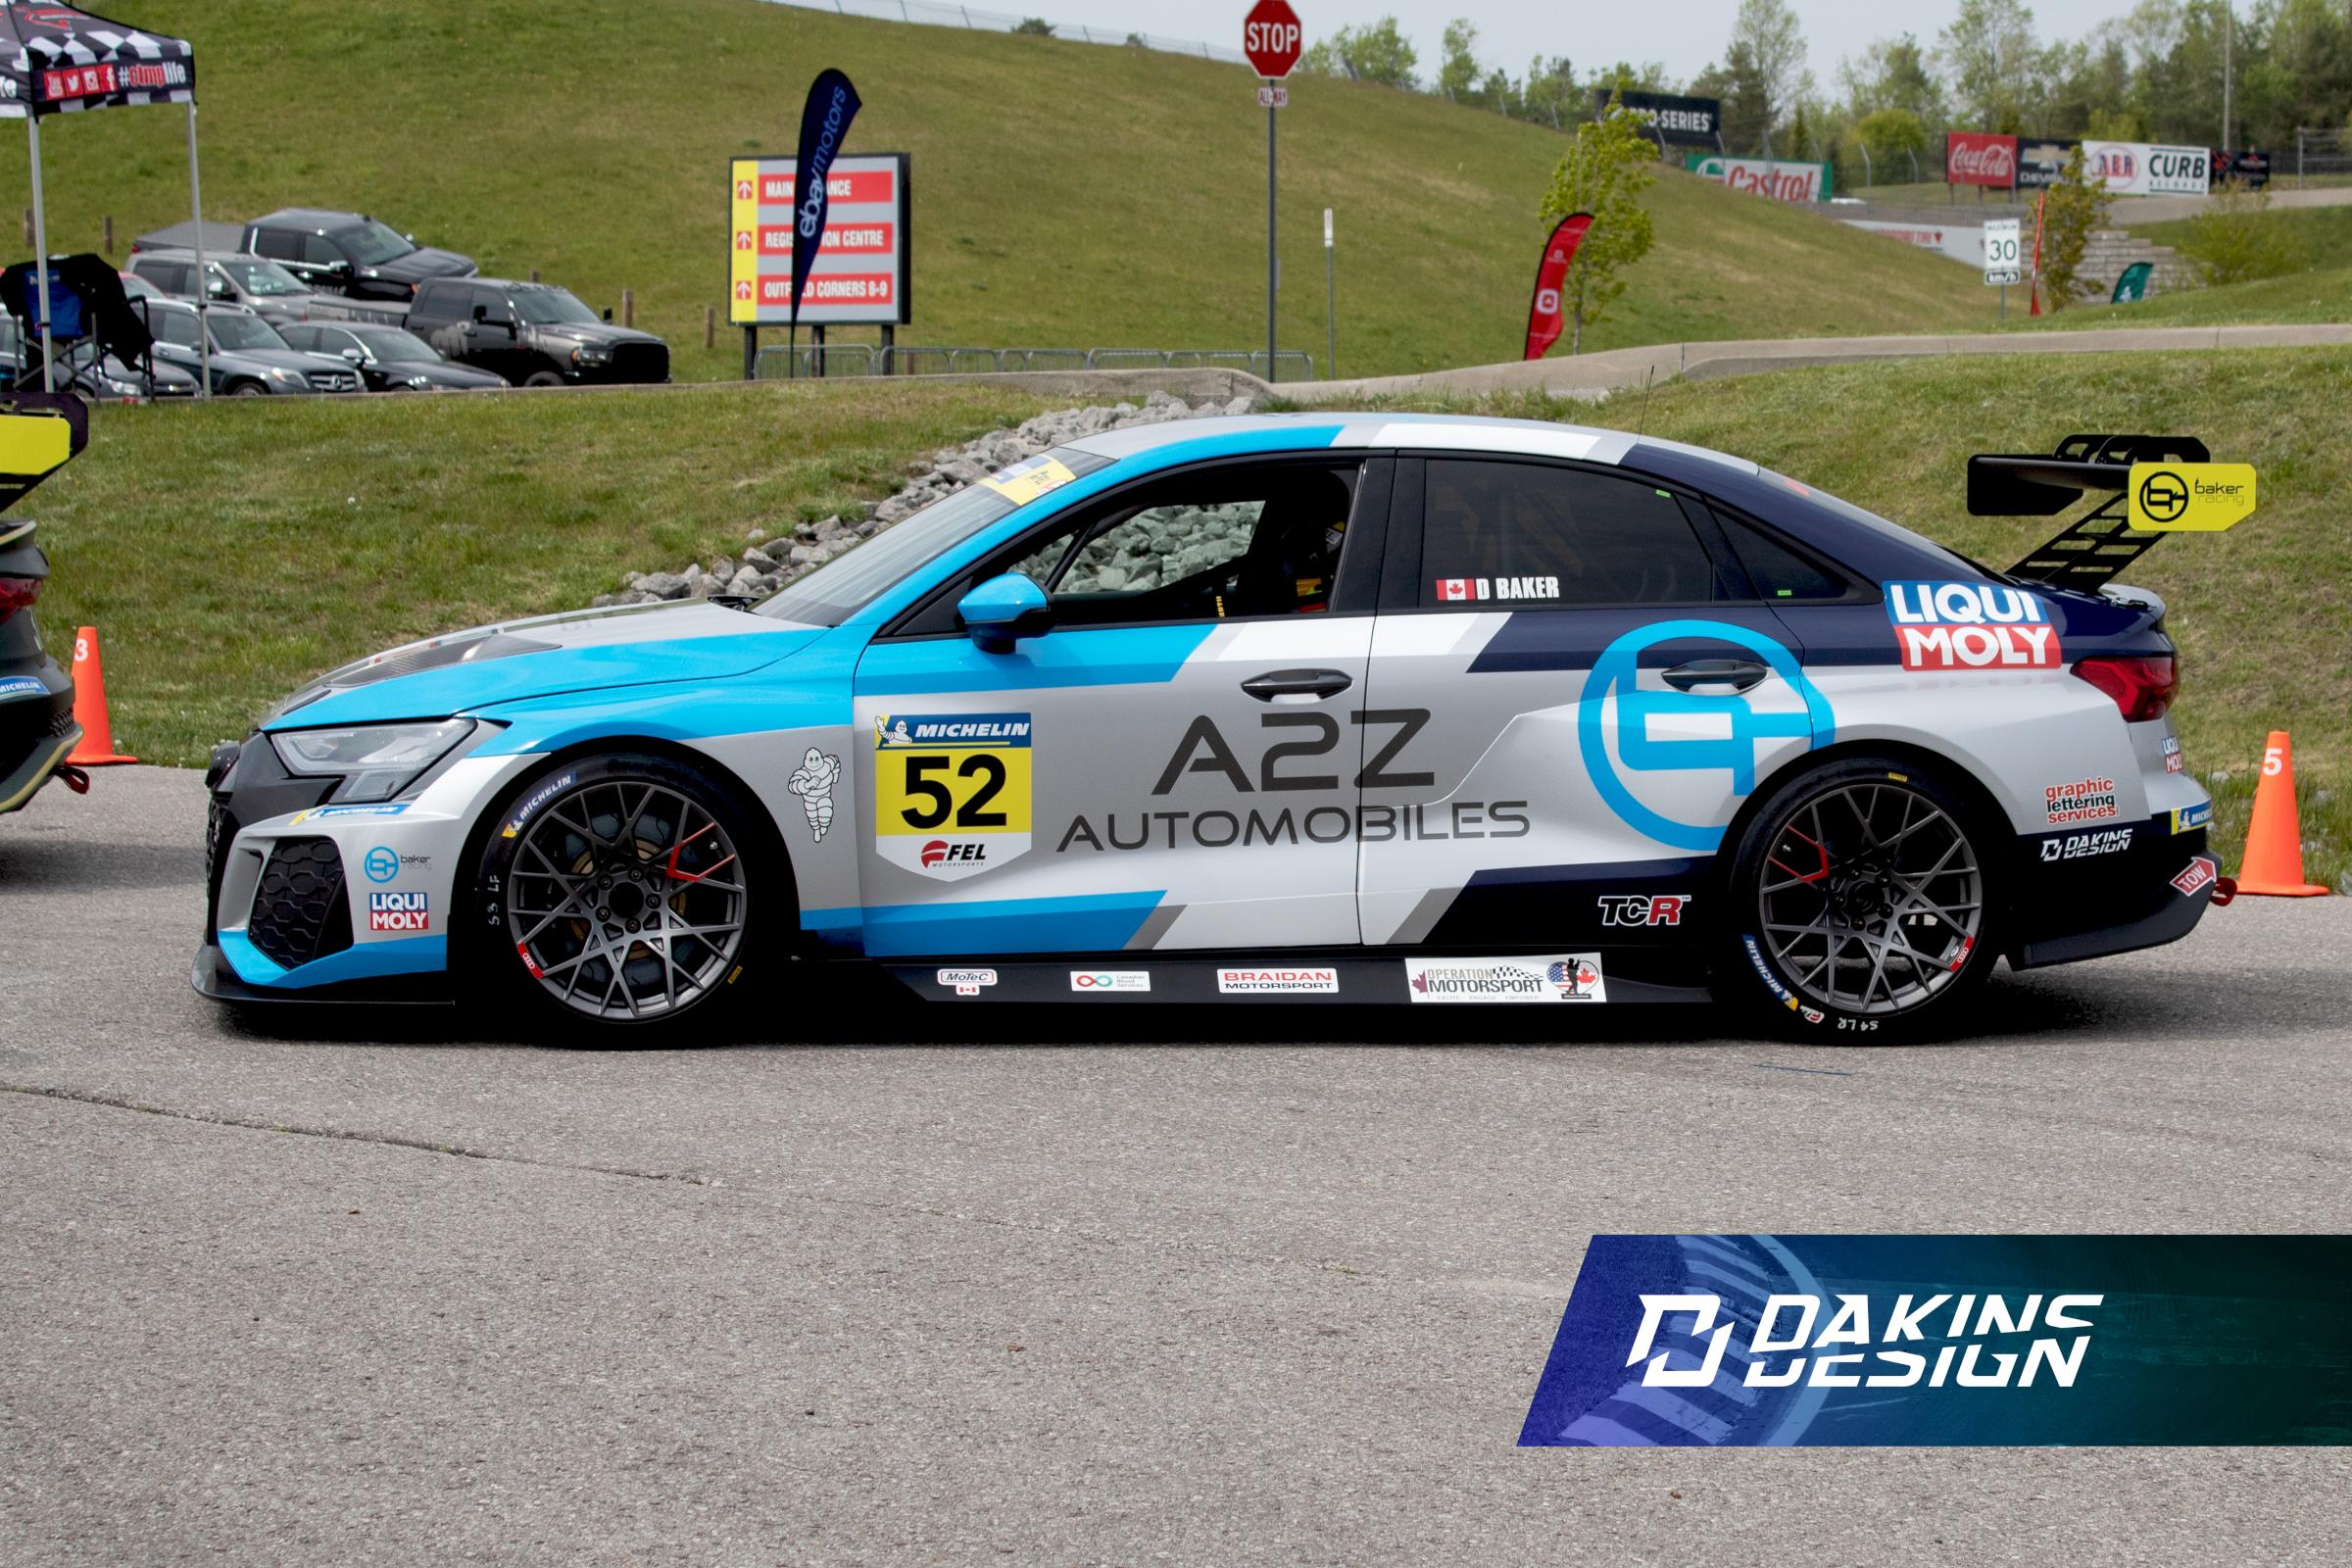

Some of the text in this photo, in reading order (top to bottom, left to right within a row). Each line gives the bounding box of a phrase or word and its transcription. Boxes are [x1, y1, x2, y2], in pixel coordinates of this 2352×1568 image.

[1247, 22, 1298, 53] STOP
[2149, 154, 2205, 178] CURB
[765, 180, 794, 198] MAIN
[1728, 166, 1813, 202] Castrol
[843, 229, 884, 247] CENTRE
[1990, 240, 2017, 262] 30
[1988, 271, 2017, 283] km/h
[816, 280, 866, 297] CORNERS
[868, 280, 888, 297] 8-9
[2194, 478, 2244, 495] baker
[2198, 494, 2244, 507] racing
[1476, 576, 1560, 600] D BAKER
[1890, 584, 2041, 624] LIQUI
[74, 638, 89, 662] 3
[1903, 626, 2051, 667] MOLY
[0, 682, 40, 694] MICHELIN
[915, 722, 1030, 738] MICHELIN
[1152, 708, 1436, 796] A2Z
[2263, 748, 2282, 775] 5
[519, 775, 571, 819] MICHELIN
[901, 754, 1007, 829] 52
[2045, 776, 2114, 802] graphic
[2047, 794, 2115, 812] lettering
[2048, 806, 2117, 824] services
[1056, 801, 1531, 854] AUTOMOBILES
[2063, 837, 2132, 859] DESIGN
[2064, 828, 2133, 852] DAKINS
[400, 855, 431, 863] baker
[947, 843, 987, 861] FEL
[487, 874, 501, 893] LF
[2178, 864, 2207, 890] TOW
[371, 893, 426, 911] LIQUI
[1597, 895, 1684, 927] TCR
[372, 911, 427, 930] MOLY
[1224, 971, 1332, 981] BRAIDAN
[1428, 968, 1494, 980] OPERATION
[1745, 939, 1784, 994] MICHELIN
[1429, 979, 1544, 993] MOTORSPORT
[1838, 1017, 1879, 1031] S4 LR
